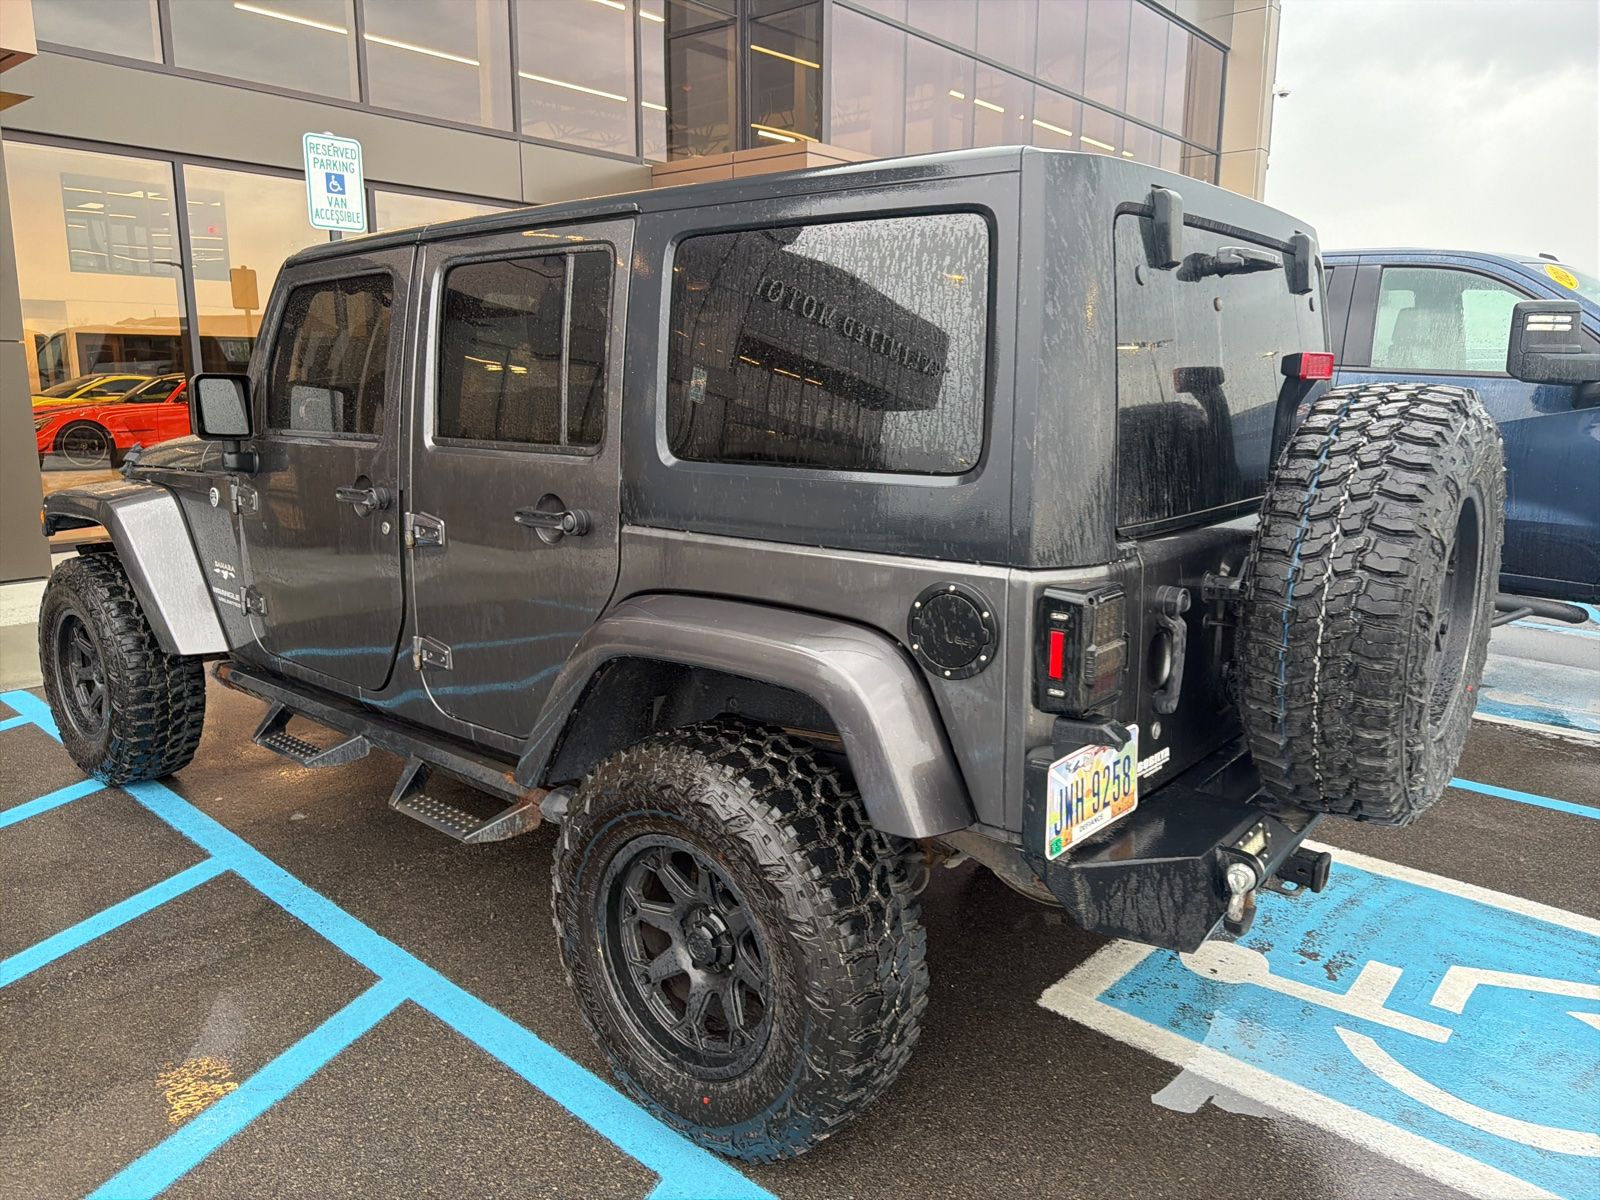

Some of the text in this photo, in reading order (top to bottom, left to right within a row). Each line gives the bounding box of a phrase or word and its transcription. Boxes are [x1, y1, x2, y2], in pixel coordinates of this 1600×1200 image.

[309, 142, 357, 160] RESERVED
[313, 157, 355, 174] PARKING
[327, 196, 348, 209] VAN
[314, 208, 361, 223] ACCESSIBLE
[1092, 754, 1131, 814] 9258
